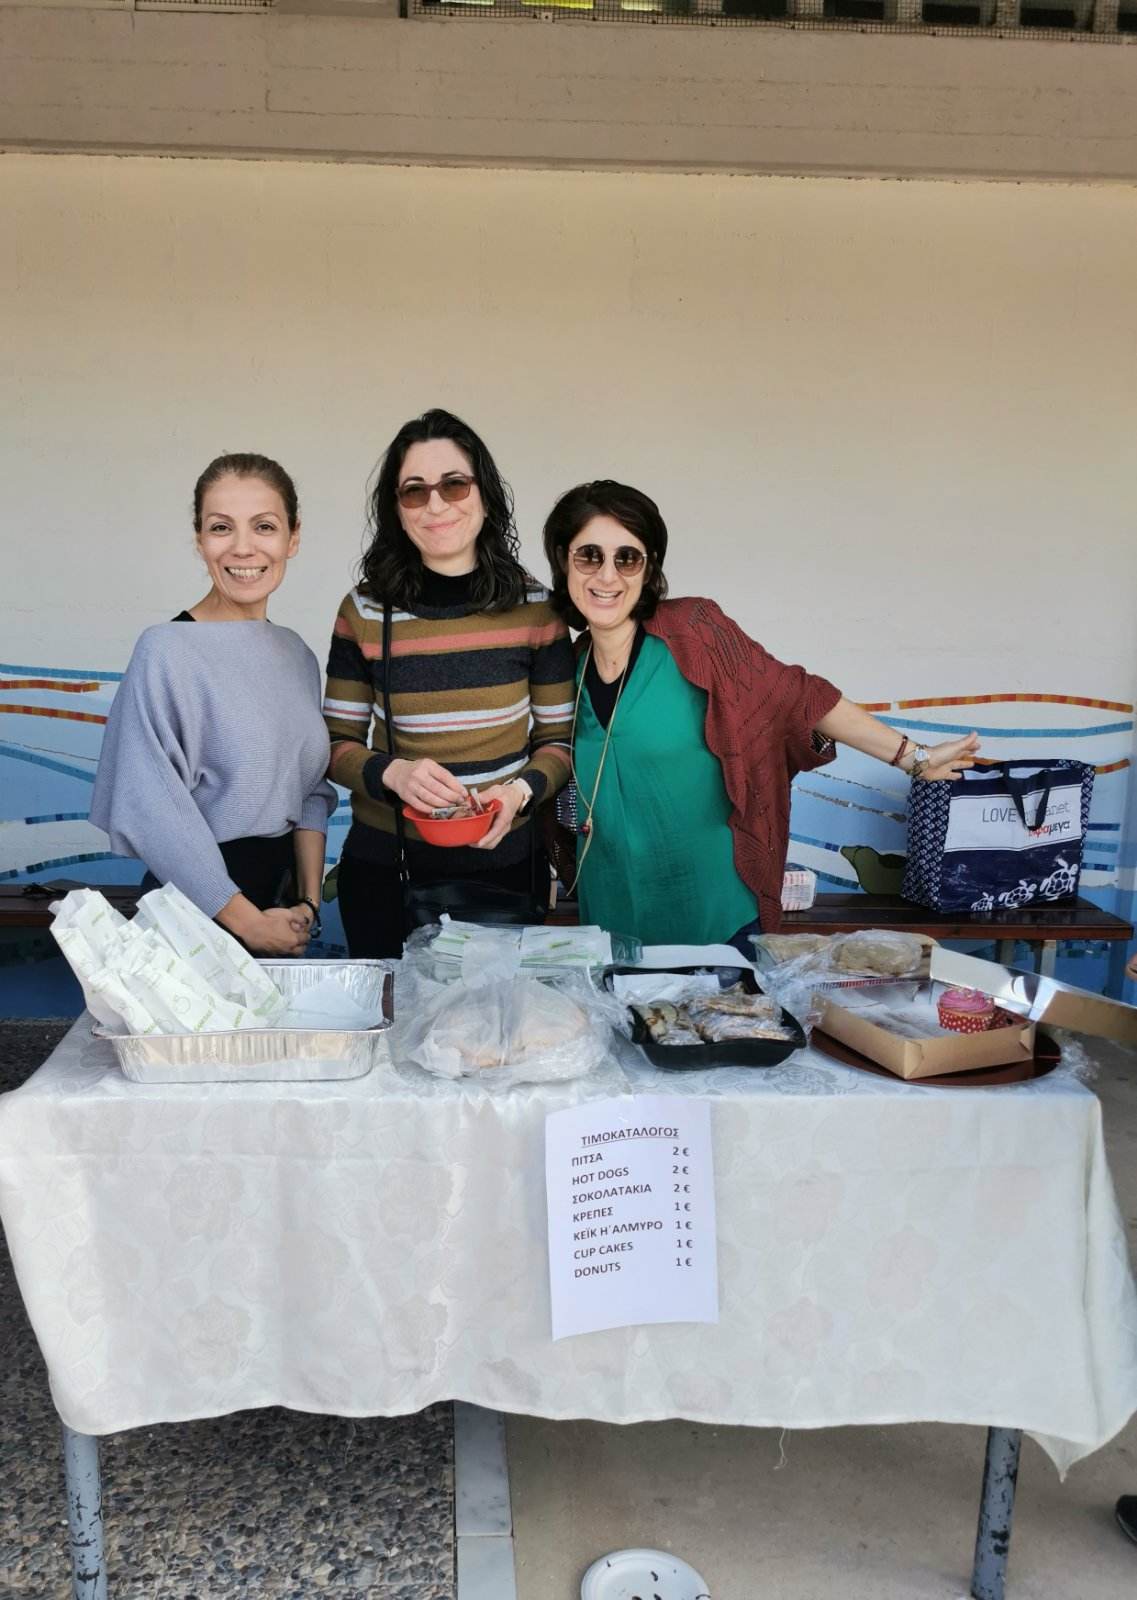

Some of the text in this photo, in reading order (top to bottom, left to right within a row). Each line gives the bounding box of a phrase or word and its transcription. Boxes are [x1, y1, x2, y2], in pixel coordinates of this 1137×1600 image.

[982, 807, 1017, 823] LOVE
[581, 1127, 679, 1145] ΤΙΜΟΚΑΤΑΛΟΓΟΣ
[572, 1147, 690, 1166] ΠΙΤΣΑ 2 €
[572, 1173, 594, 1185] HOT
[598, 1167, 629, 1180] DOGS
[683, 1166, 688, 1174] €
[573, 1184, 690, 1204] ΣΟΚΟΛΑΤΑΚΙΑ 2 €
[573, 1202, 690, 1222] ΚΡΕΠΕΣ 1 €
[574, 1228, 597, 1241] ΚΕΪΚ
[676, 1221, 681, 1229] 1
[685, 1221, 692, 1229] €
[574, 1239, 693, 1259] CUP CAKES 1 €
[574, 1258, 692, 1278] DONUTS 1 €
